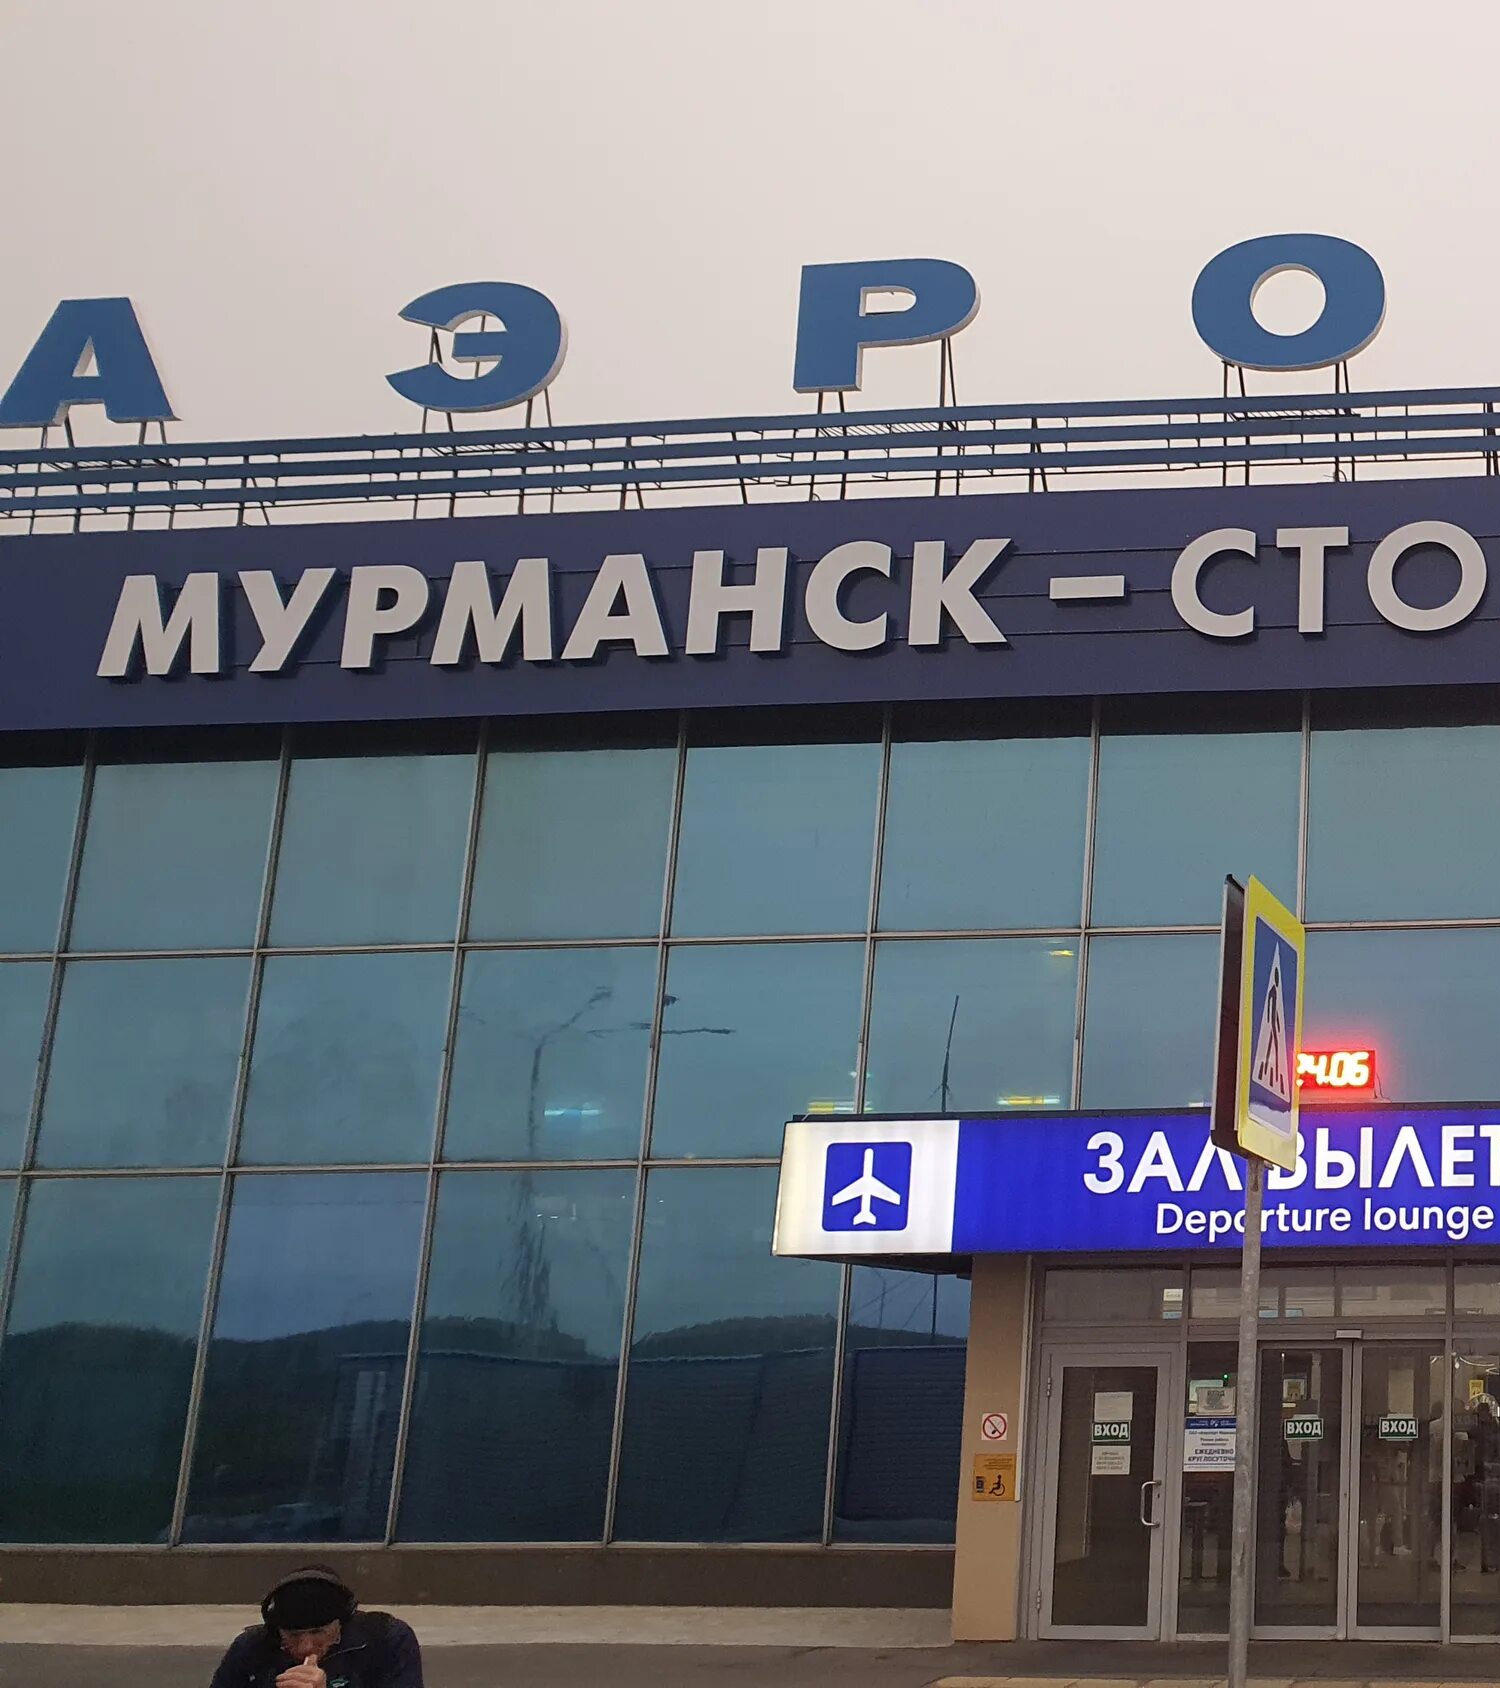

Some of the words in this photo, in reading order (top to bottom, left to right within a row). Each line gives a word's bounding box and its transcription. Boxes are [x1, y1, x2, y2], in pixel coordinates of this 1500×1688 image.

[95, 537, 1013, 679] МУРМАНСК
[1083, 1131, 1243, 1194] ЗАЛ
[1364, 1198, 1494, 1240] lounge
[1094, 1423, 1128, 1438] ВХОД
[1286, 1421, 1321, 1435] ВХОД
[1381, 1420, 1416, 1434] ВХОД
